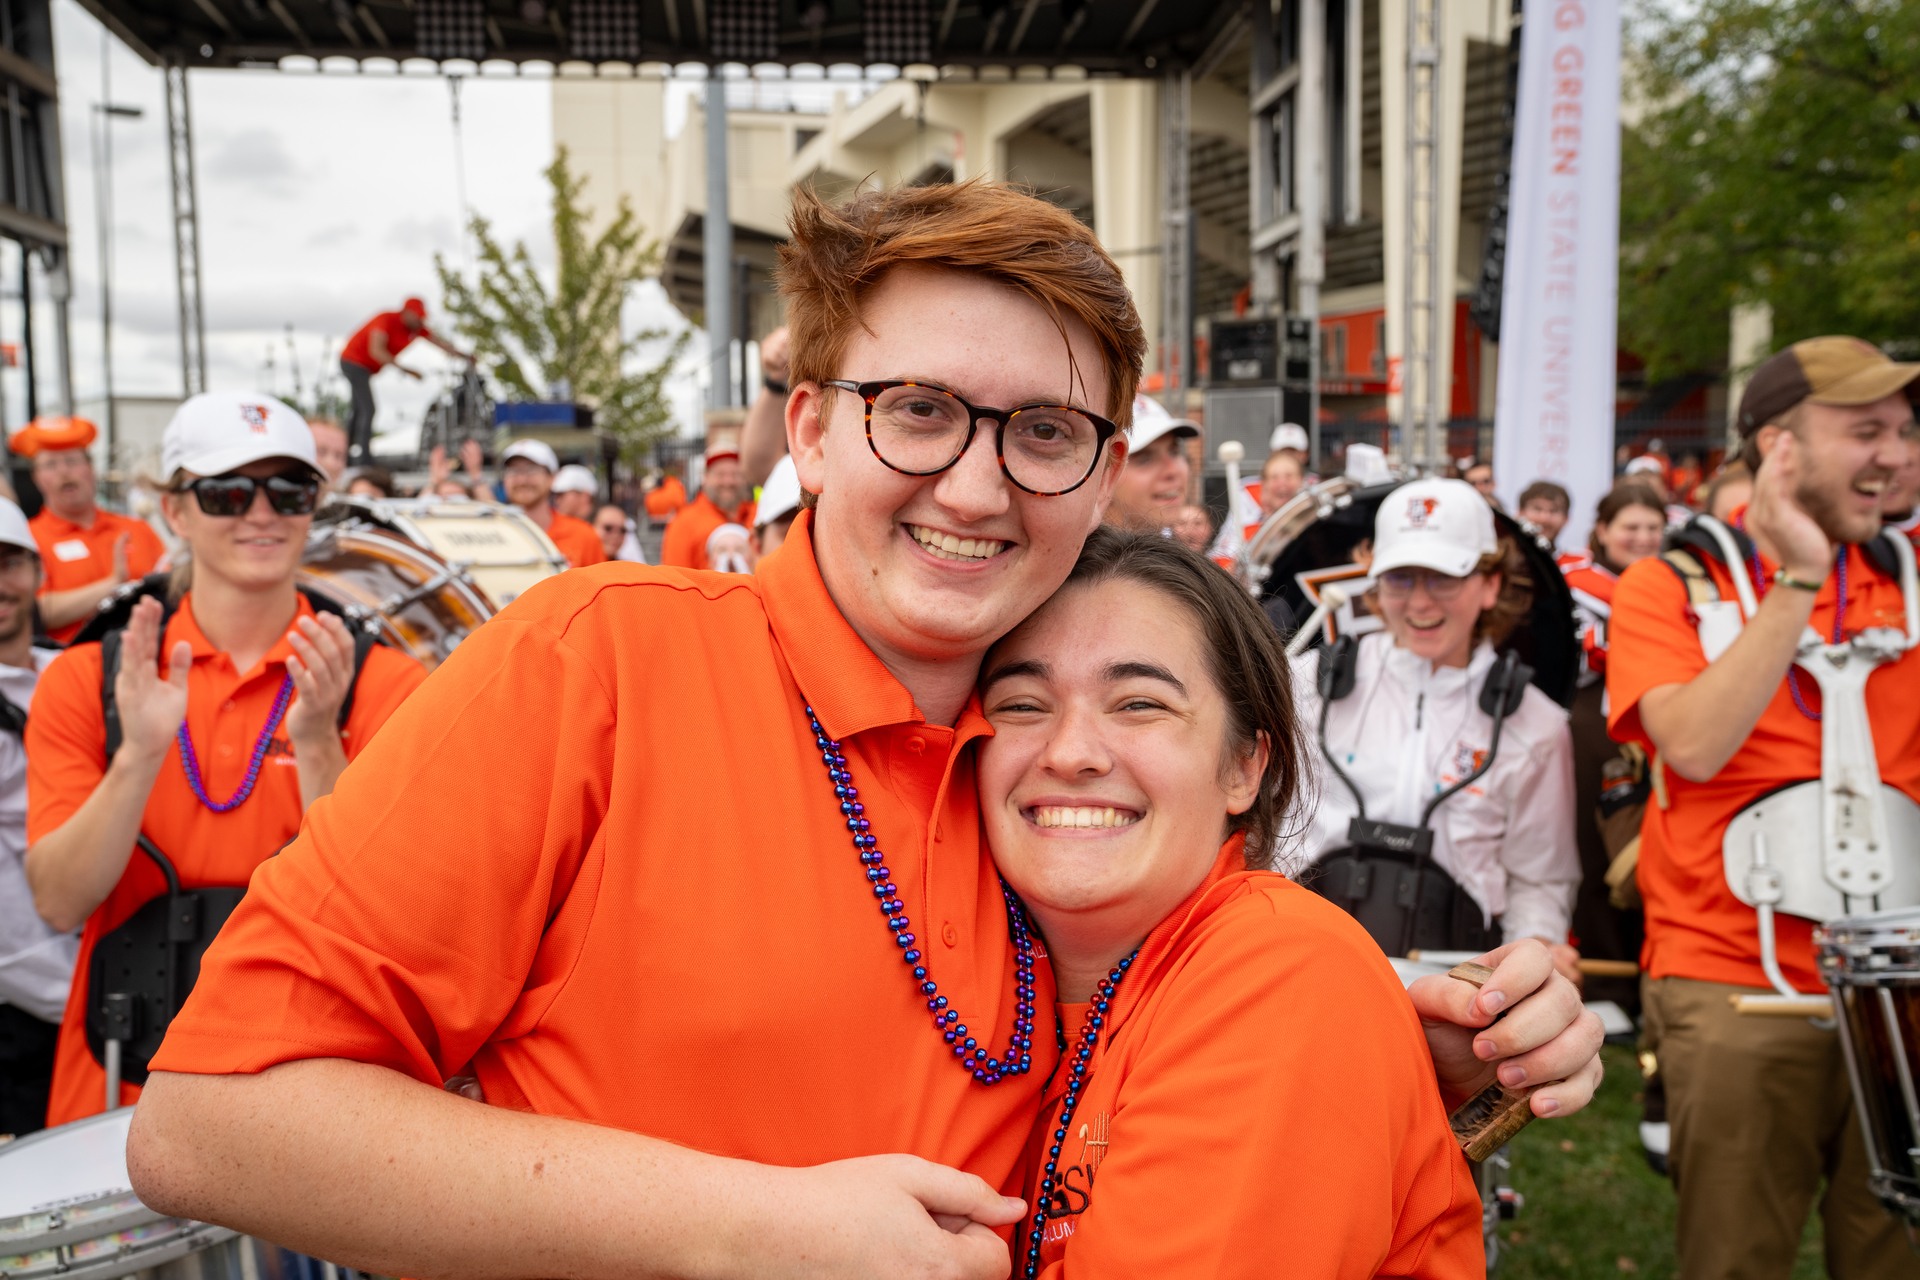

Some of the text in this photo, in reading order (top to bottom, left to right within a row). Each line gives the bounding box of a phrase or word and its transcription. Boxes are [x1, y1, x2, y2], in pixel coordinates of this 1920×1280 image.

[1552, 0, 1586, 32] G
[1550, 44, 1585, 176] GREEN
[1544, 189, 1581, 302] STATE
